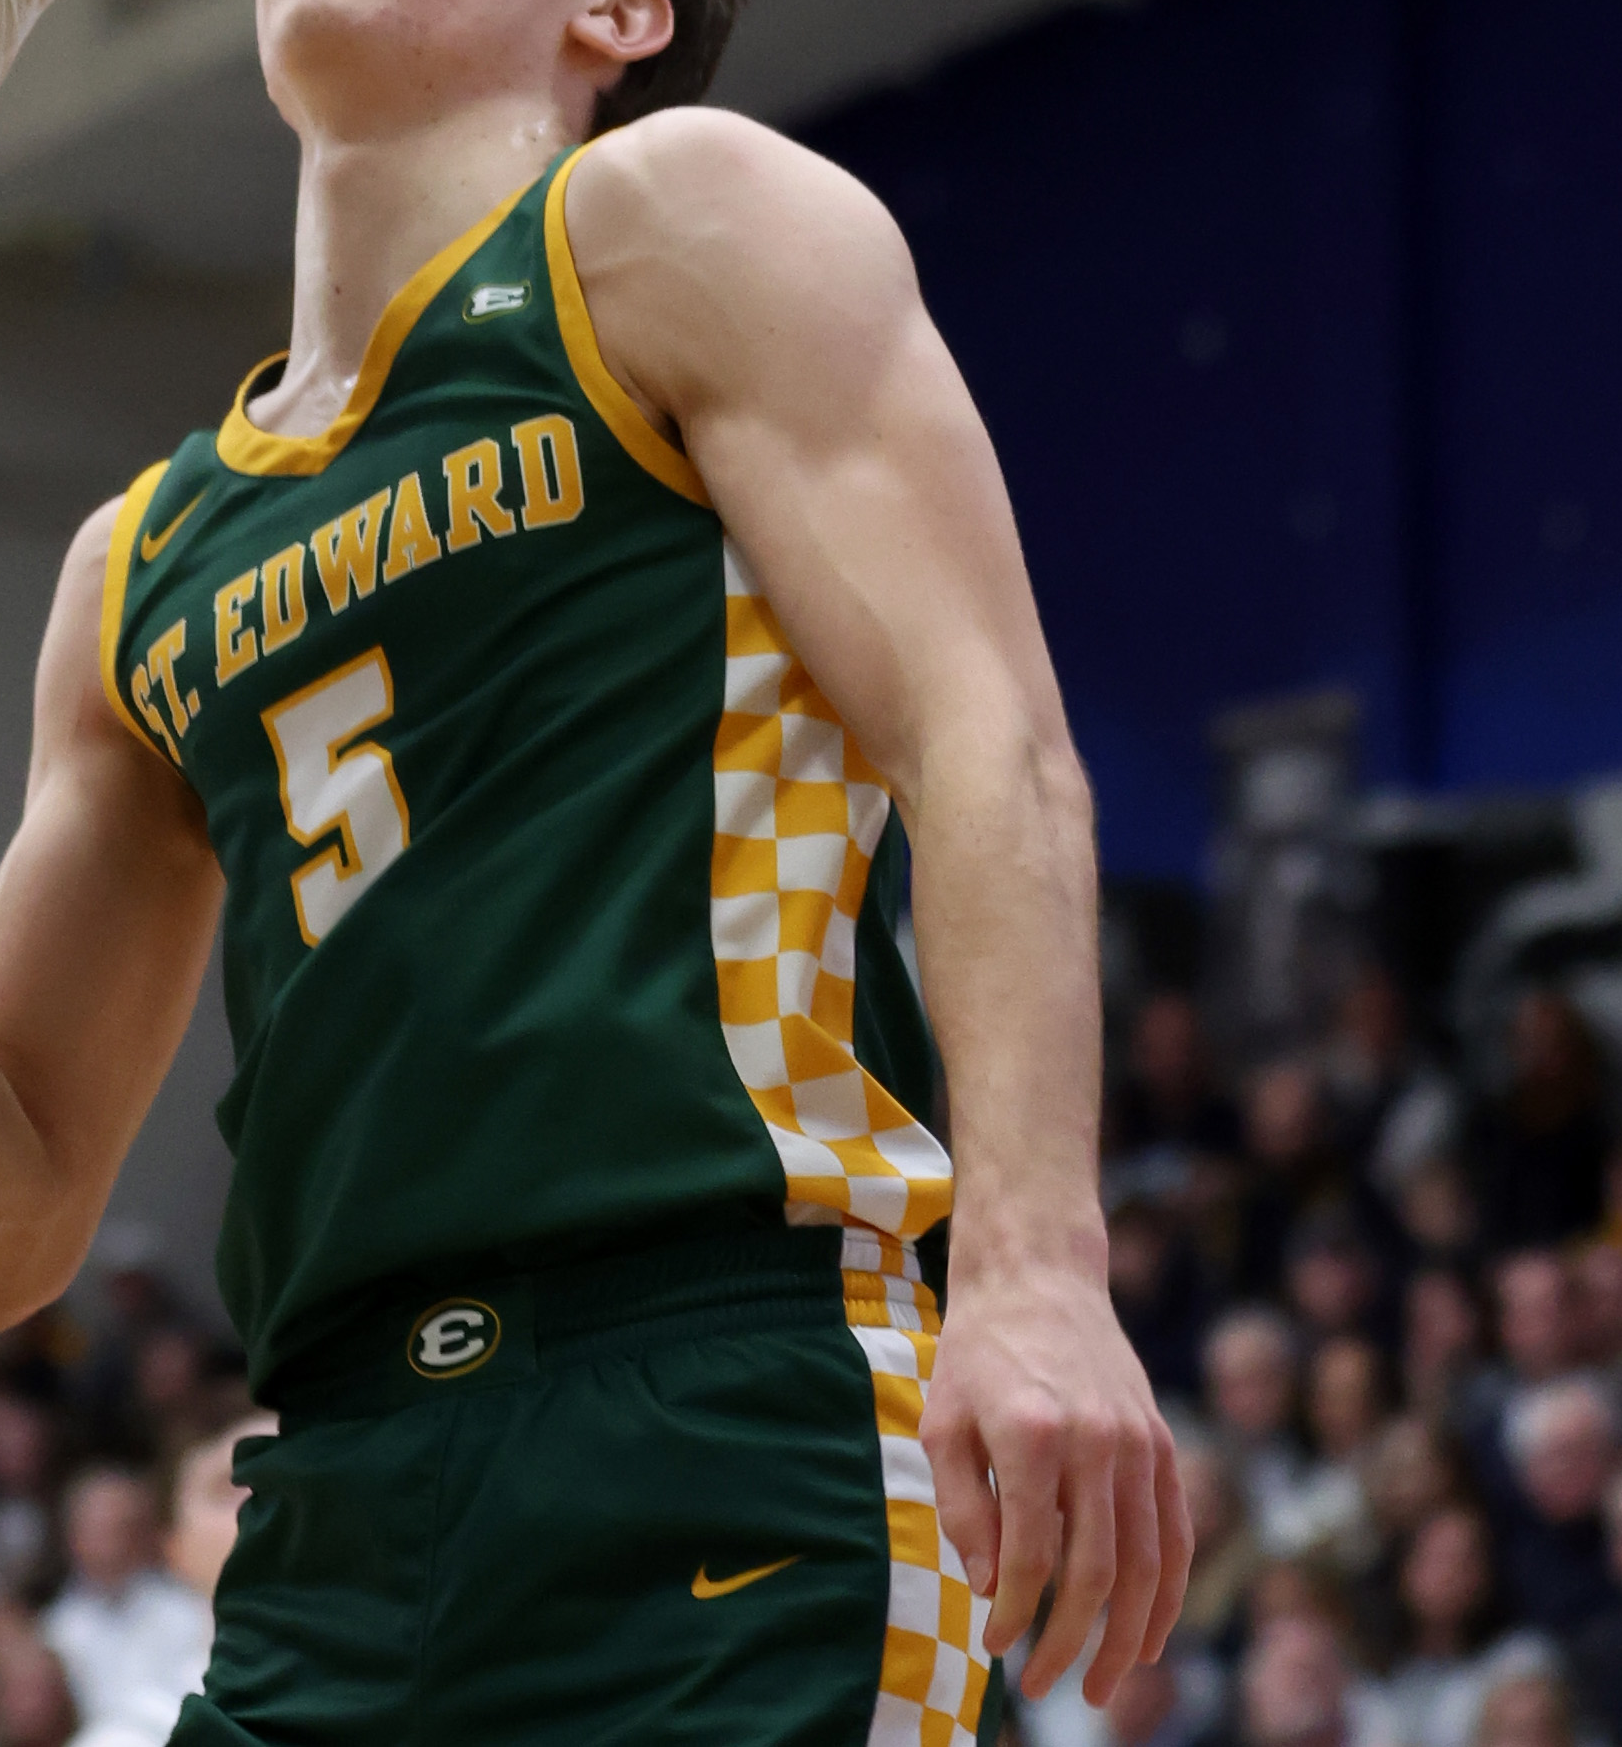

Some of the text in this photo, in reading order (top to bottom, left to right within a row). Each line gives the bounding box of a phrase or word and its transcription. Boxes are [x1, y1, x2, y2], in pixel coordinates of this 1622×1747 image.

[130, 413, 585, 767] ST. EDWARD
[260, 643, 410, 949] 5
